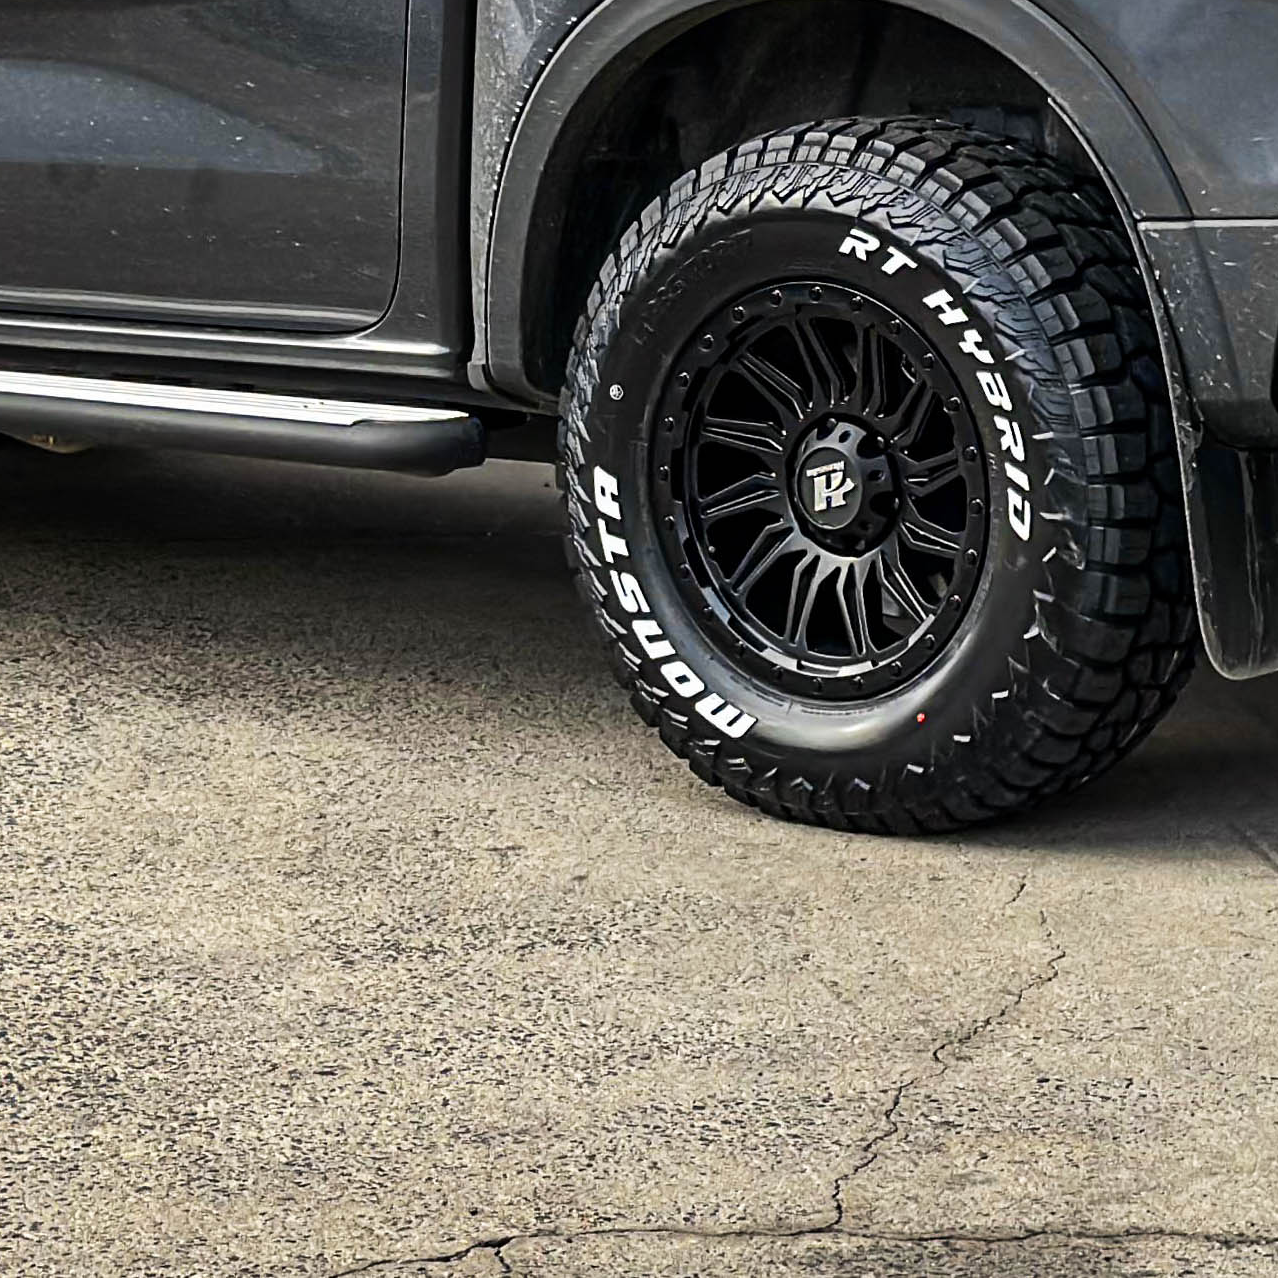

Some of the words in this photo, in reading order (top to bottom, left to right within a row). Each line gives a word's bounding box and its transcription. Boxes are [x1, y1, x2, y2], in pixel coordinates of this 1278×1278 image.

[838, 227, 919, 277] RT
[922, 288, 1033, 542] HYBRID
[592, 464, 757, 740] MONSTA
